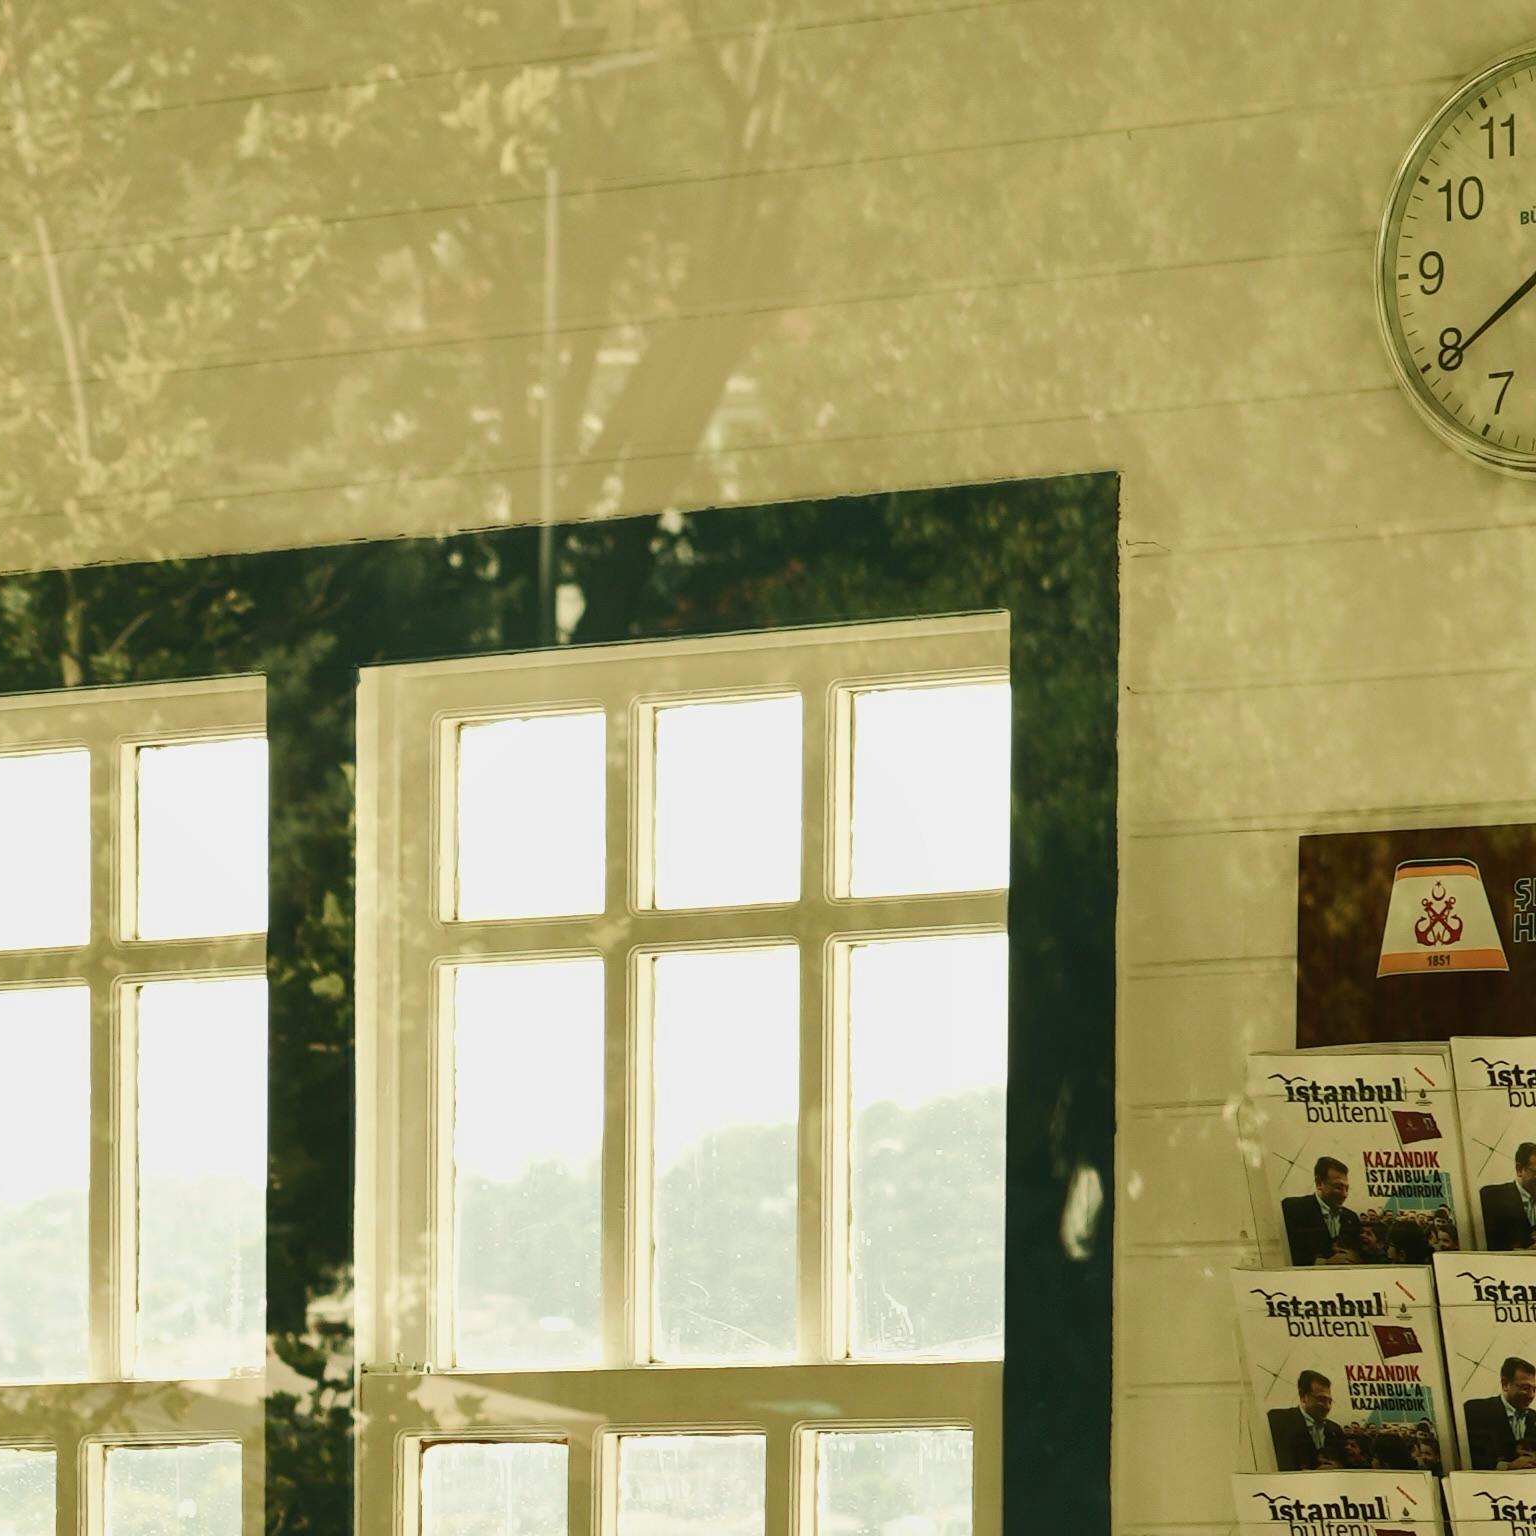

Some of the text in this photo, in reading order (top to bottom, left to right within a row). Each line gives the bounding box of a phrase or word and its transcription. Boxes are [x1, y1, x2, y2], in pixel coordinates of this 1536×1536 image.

[1480, 114, 1516, 160] 11
[1437, 176, 1484, 222] 10
[1418, 250, 1446, 296] 9
[1437, 327, 1464, 371] 8
[1488, 371, 1515, 415] 7
[1427, 954, 1451, 967] 1851
[1284, 1077, 1405, 1103] istanbul
[1306, 1098, 1389, 1123] bülteni
[1363, 1151, 1440, 1168] KAZANDIK
[1368, 1184, 1444, 1198] KAZANDIRDIK
[1265, 1291, 1385, 1317] istanbul
[1287, 1315, 1370, 1338] bülteni
[1345, 1365, 1421, 1382] KAZANDIK
[1351, 1398, 1425, 1411] KAZANDIRDIK
[1269, 1496, 1388, 1520] istanbul
